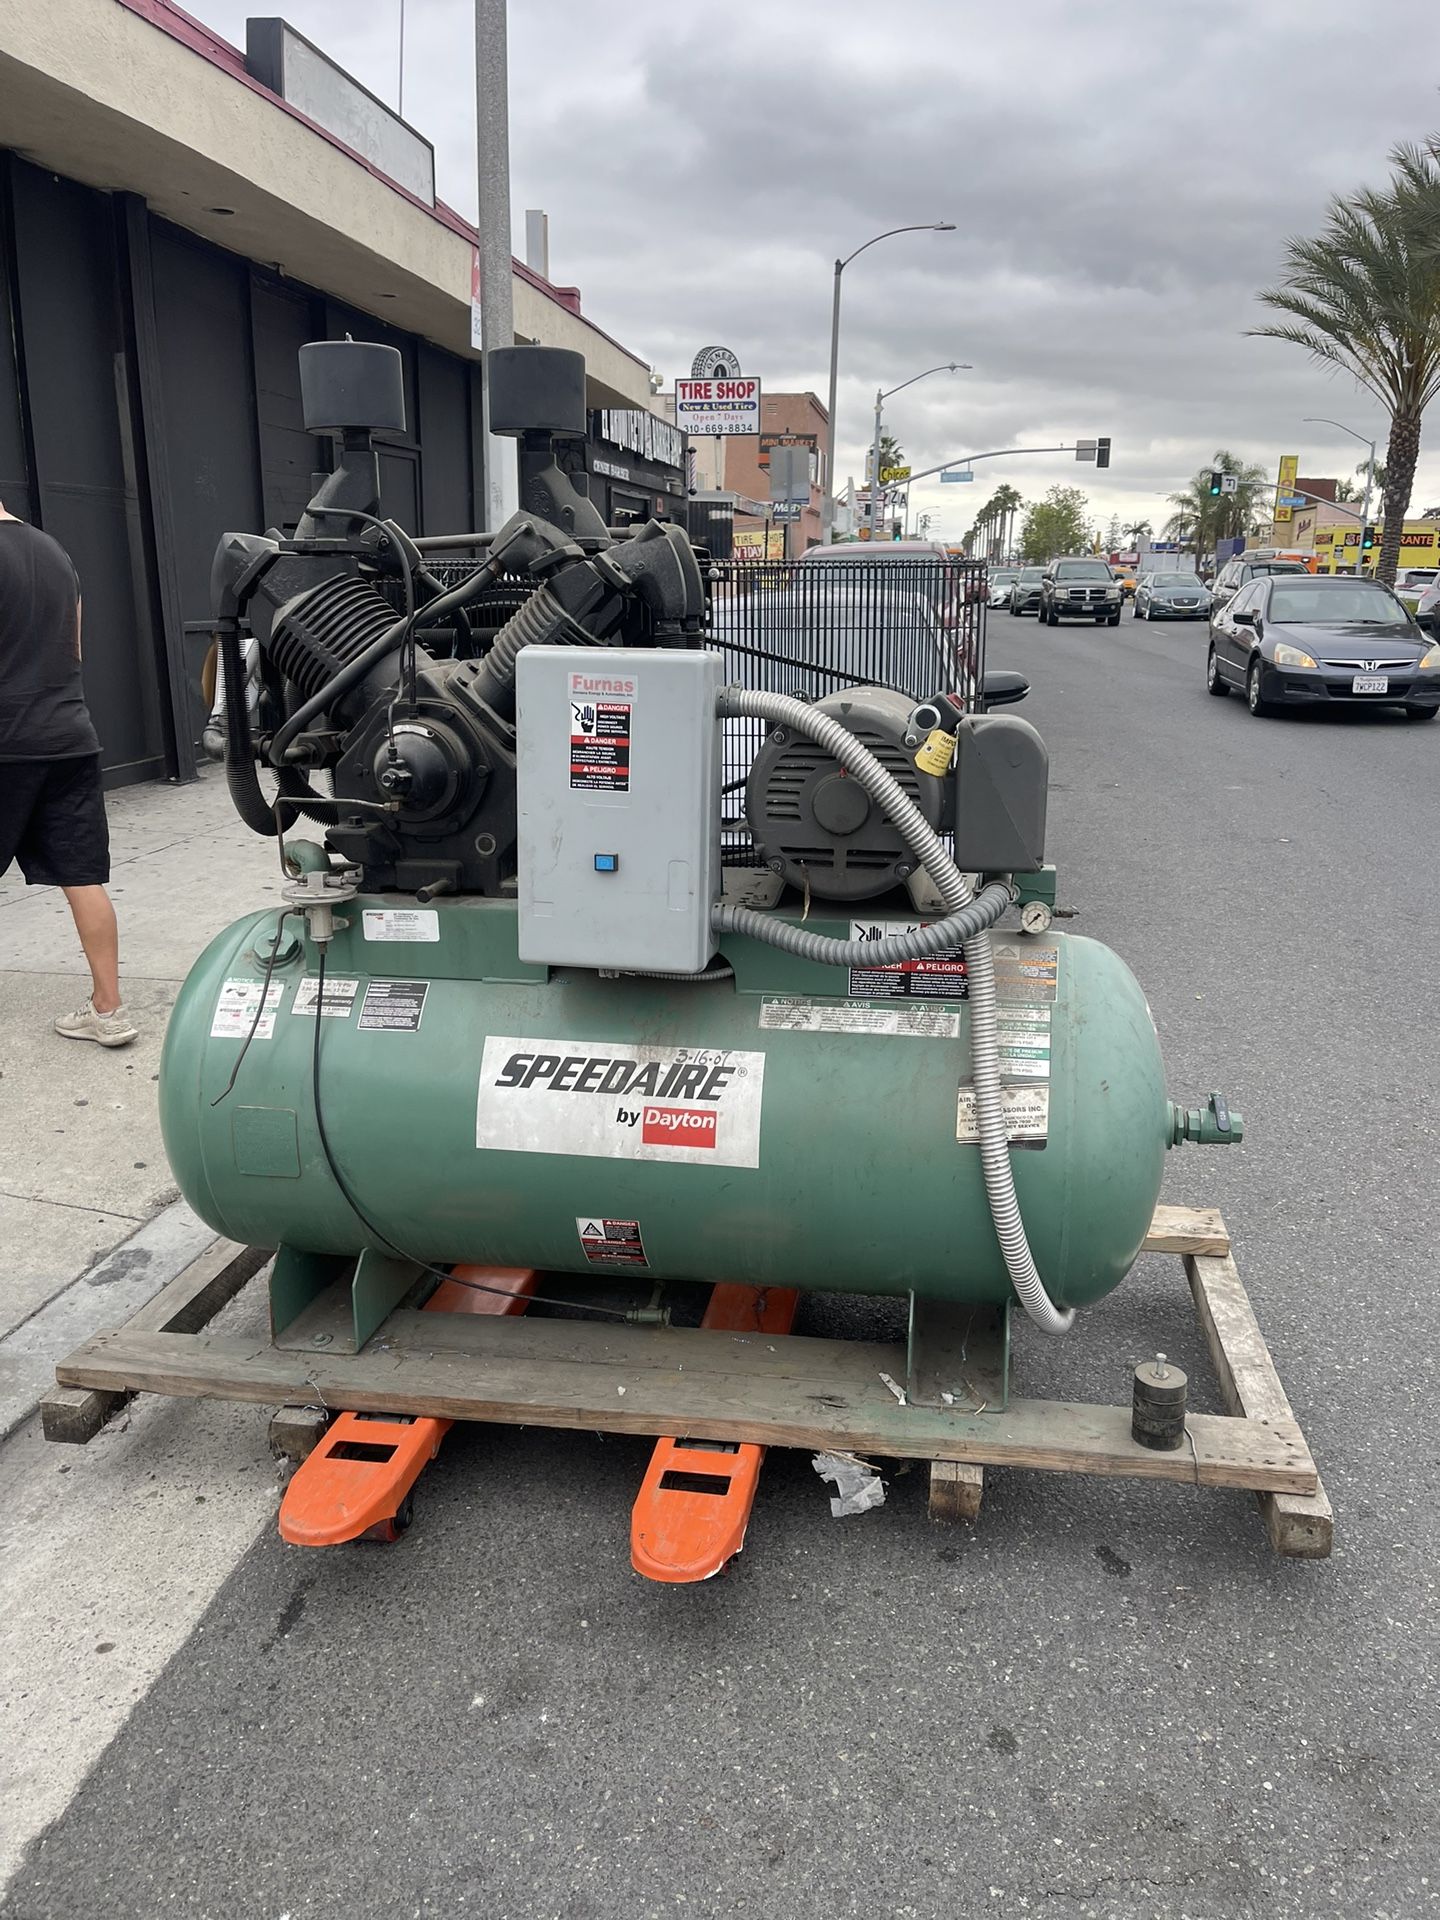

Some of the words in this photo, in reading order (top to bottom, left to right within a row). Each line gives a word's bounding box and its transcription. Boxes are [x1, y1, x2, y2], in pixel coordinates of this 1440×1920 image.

[679, 382, 712, 400] TIRE
[716, 382, 755, 399] SHOP
[682, 403, 702, 411] New
[734, 402, 753, 410] Tire
[693, 413, 715, 423] Open
[724, 413, 743, 422] Days
[684, 424, 752, 433] 310-669-8834
[762, 439, 779, 447] MINI
[782, 439, 816, 447] MARKET
[735, 534, 753, 544] TIRE
[572, 674, 634, 692] Furnas
[603, 704, 629, 712] DANGER
[926, 964, 964, 972] PELIGRO
[851, 1001, 871, 1009] AVIS
[616, 1108, 640, 1127] by
[645, 1109, 715, 1129] Dayton
